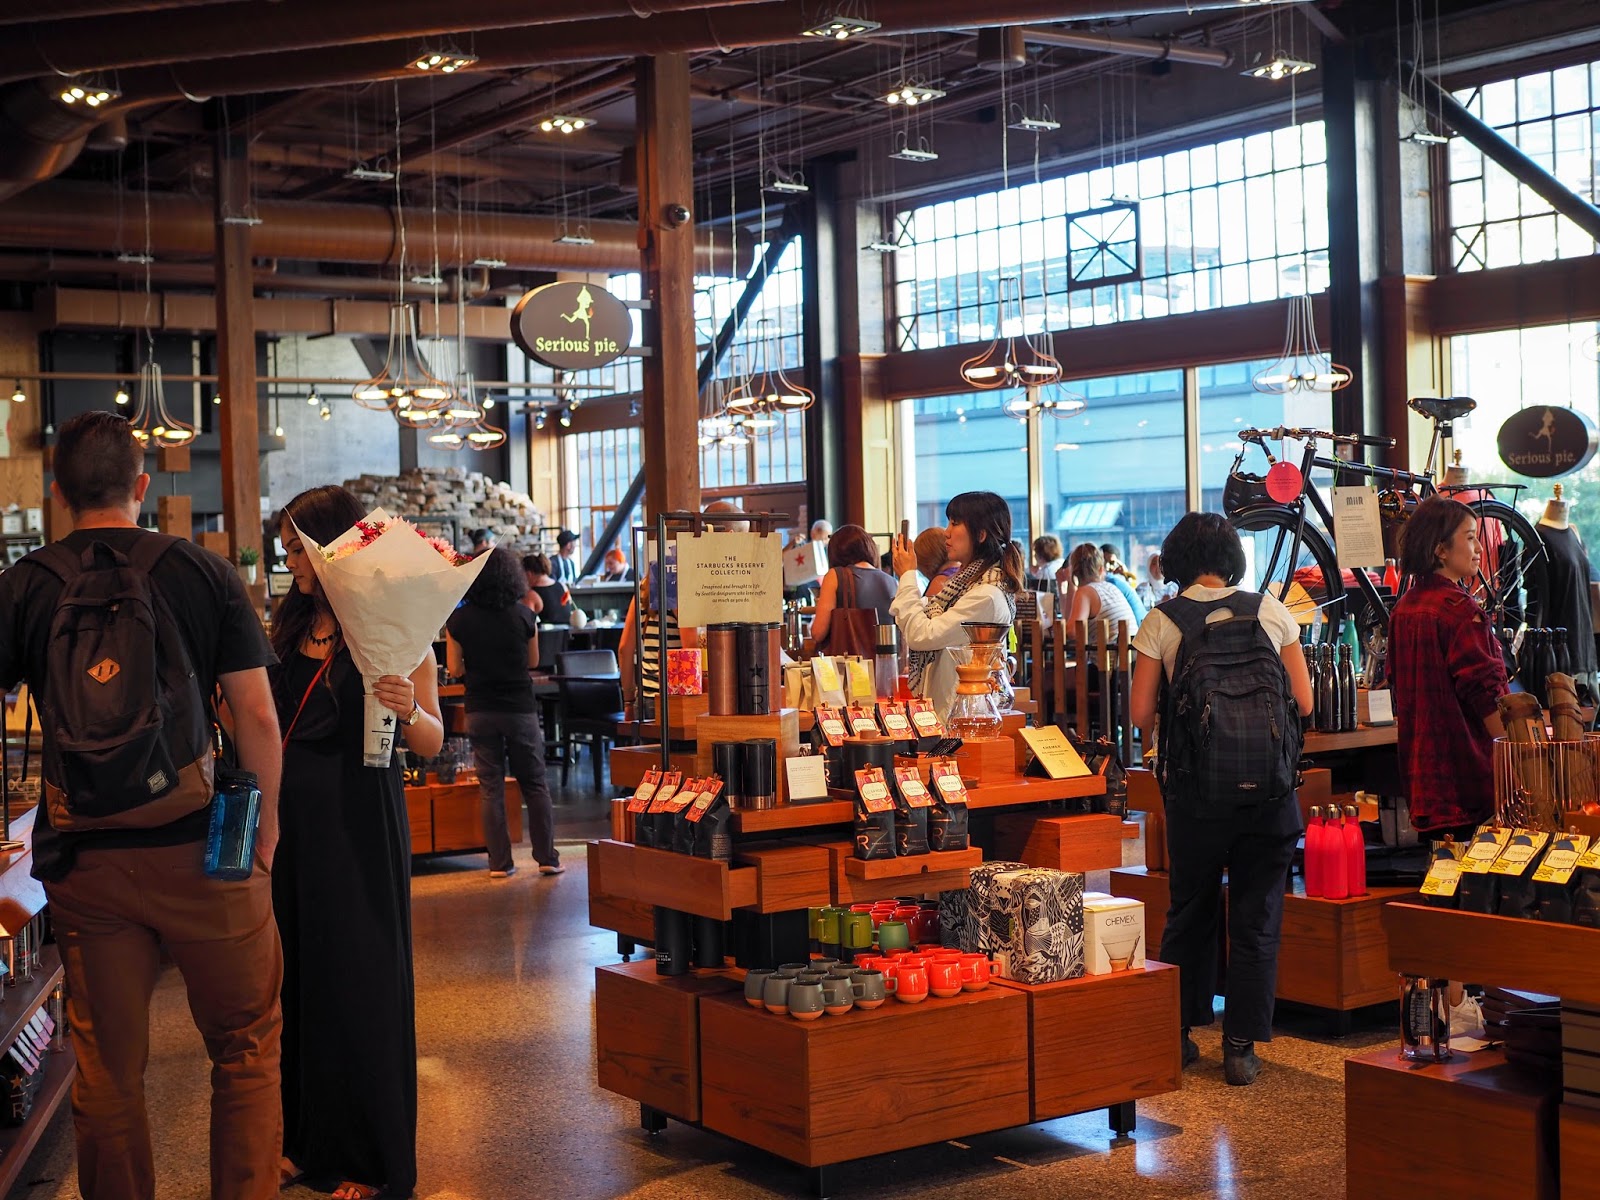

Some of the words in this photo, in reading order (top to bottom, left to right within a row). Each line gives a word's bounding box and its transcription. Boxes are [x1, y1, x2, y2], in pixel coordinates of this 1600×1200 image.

[536, 337, 589, 352] Serious
[594, 338, 619, 356] pie.
[1508, 451, 1551, 465] Serious
[1555, 450, 1576, 466] pie.
[752, 695, 763, 710] R
[381, 738, 391, 750] R
[857, 835, 870, 850] R
[1105, 915, 1135, 926] CHEMEX
[13, 1102, 25, 1118] R
